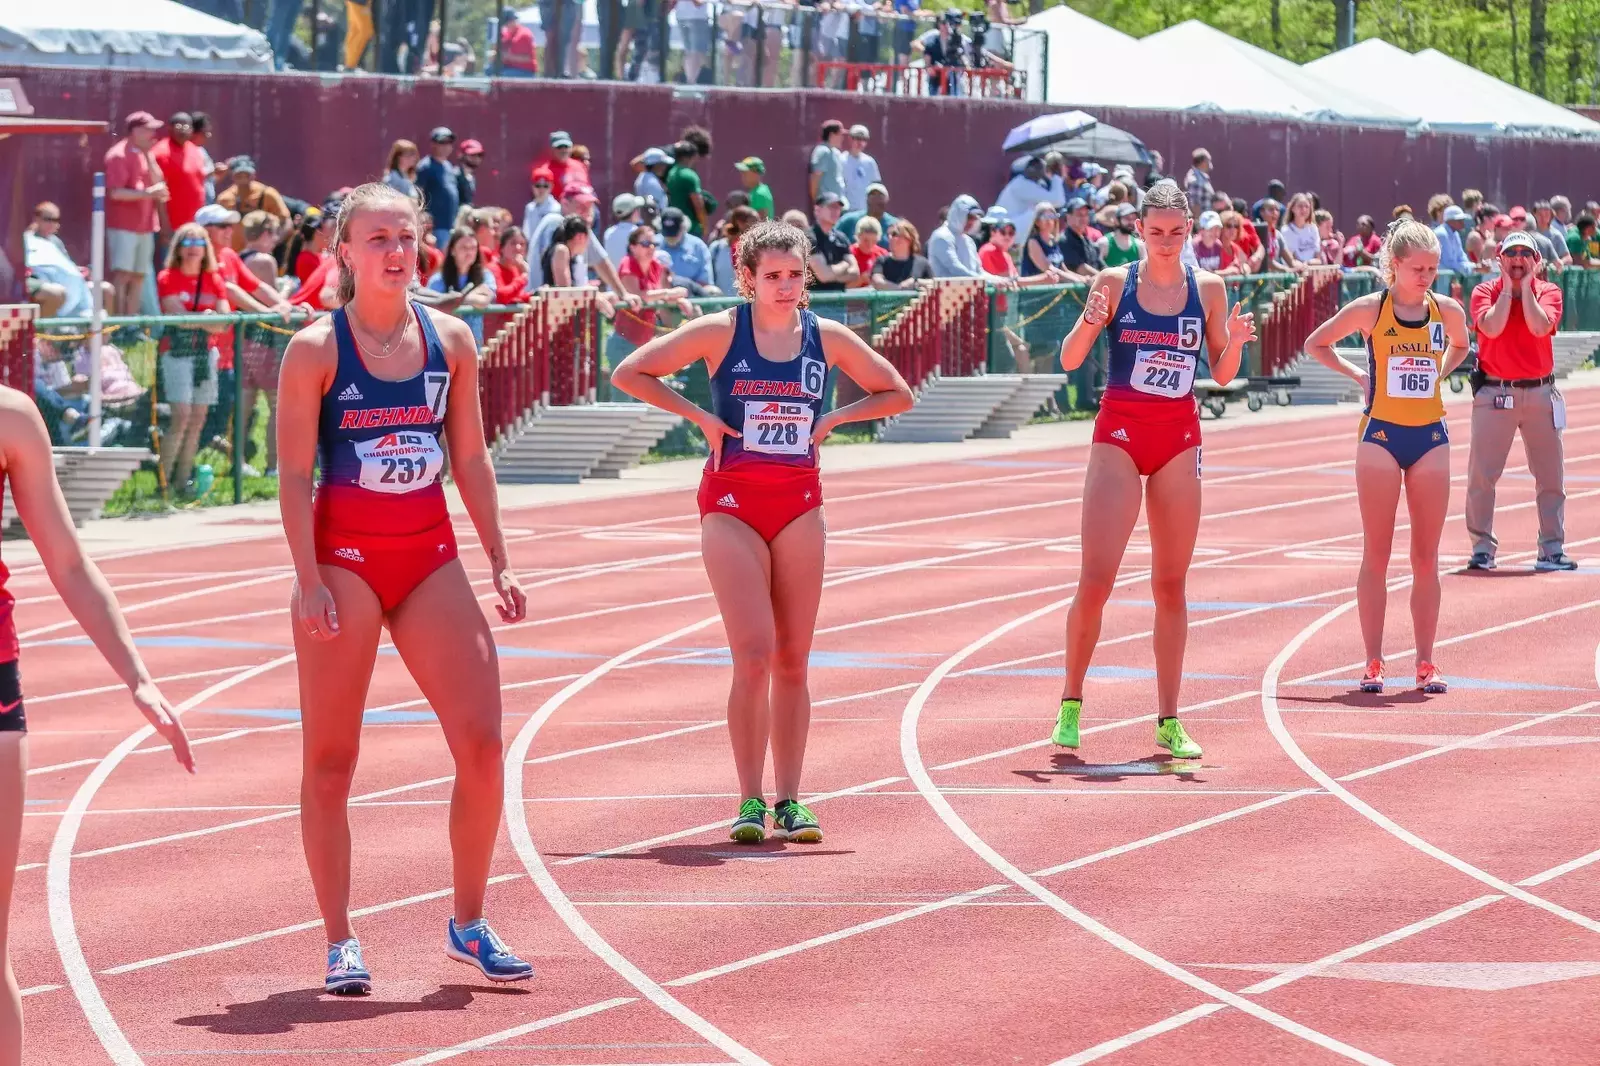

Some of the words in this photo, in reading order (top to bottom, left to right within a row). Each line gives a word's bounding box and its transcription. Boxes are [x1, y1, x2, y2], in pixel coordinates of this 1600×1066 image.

[1181, 319, 1198, 348] 5
[1432, 323, 1443, 349] 4
[1140, 358, 1191, 371] CHAMPIONSHIPS
[1400, 358, 1431, 366] A10
[805, 361, 822, 394] 6
[1143, 366, 1181, 391] 224
[1399, 373, 1430, 392] 165
[338, 393, 364, 401] adidas
[428, 375, 447, 415] 7
[730, 379, 819, 399] RICHMO
[339, 405, 442, 428] RICHMO
[750, 414, 809, 422] CHAMPIONSHIPS
[759, 403, 802, 415] A10
[373, 433, 423, 450] A10
[757, 422, 799, 446] 228
[363, 446, 435, 459] CHAMPIONSHIPS
[380, 455, 427, 485] 231
[335, 550, 364, 562] adidas
